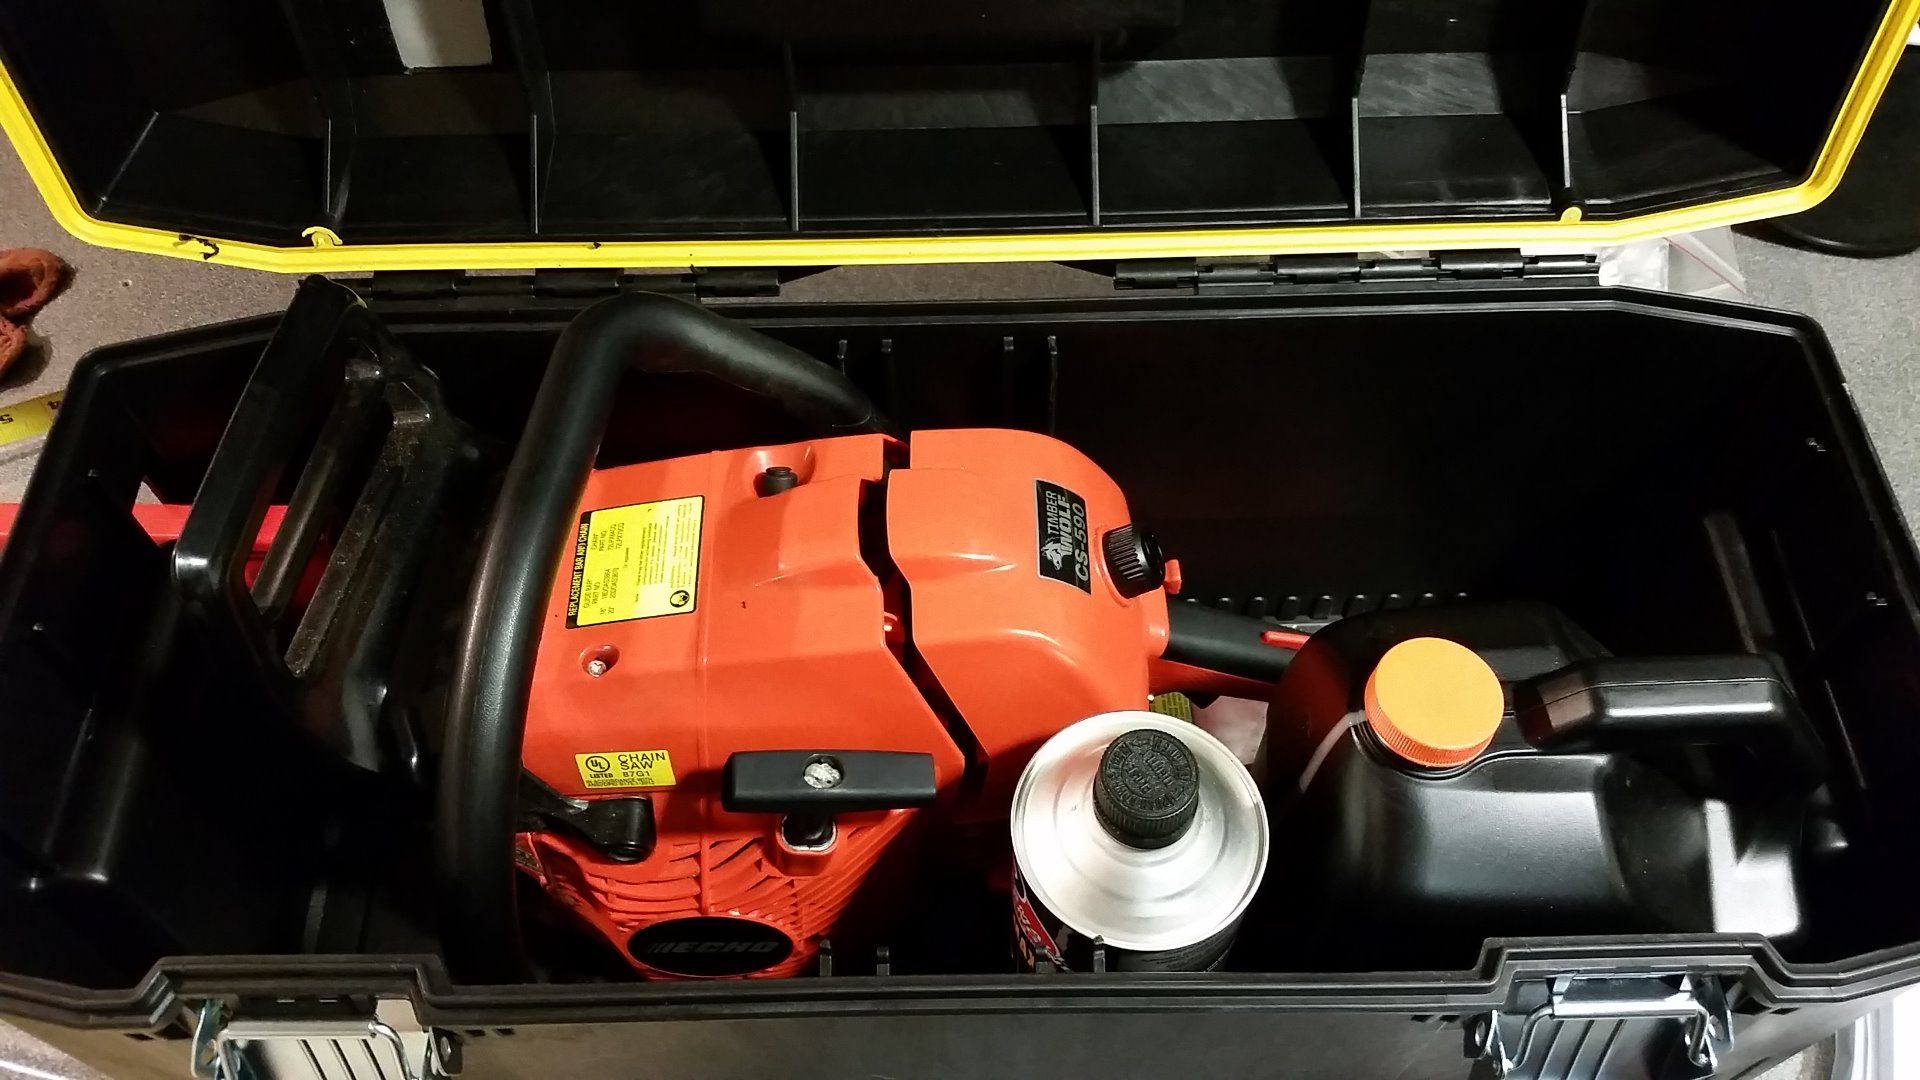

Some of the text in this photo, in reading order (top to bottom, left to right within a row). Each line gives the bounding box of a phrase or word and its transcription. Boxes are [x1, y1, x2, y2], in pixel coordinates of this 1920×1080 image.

[1046, 491, 1059, 534] TIMBER
[1058, 494, 1073, 554] WOLF
[1072, 503, 1089, 581] CS-590
[568, 523, 588, 616] REPLACEMENT BAR AND CHAIN
[618, 752, 666, 762] CHAIN
[620, 761, 653, 770] SAW
[672, 941, 779, 953] ECHO
